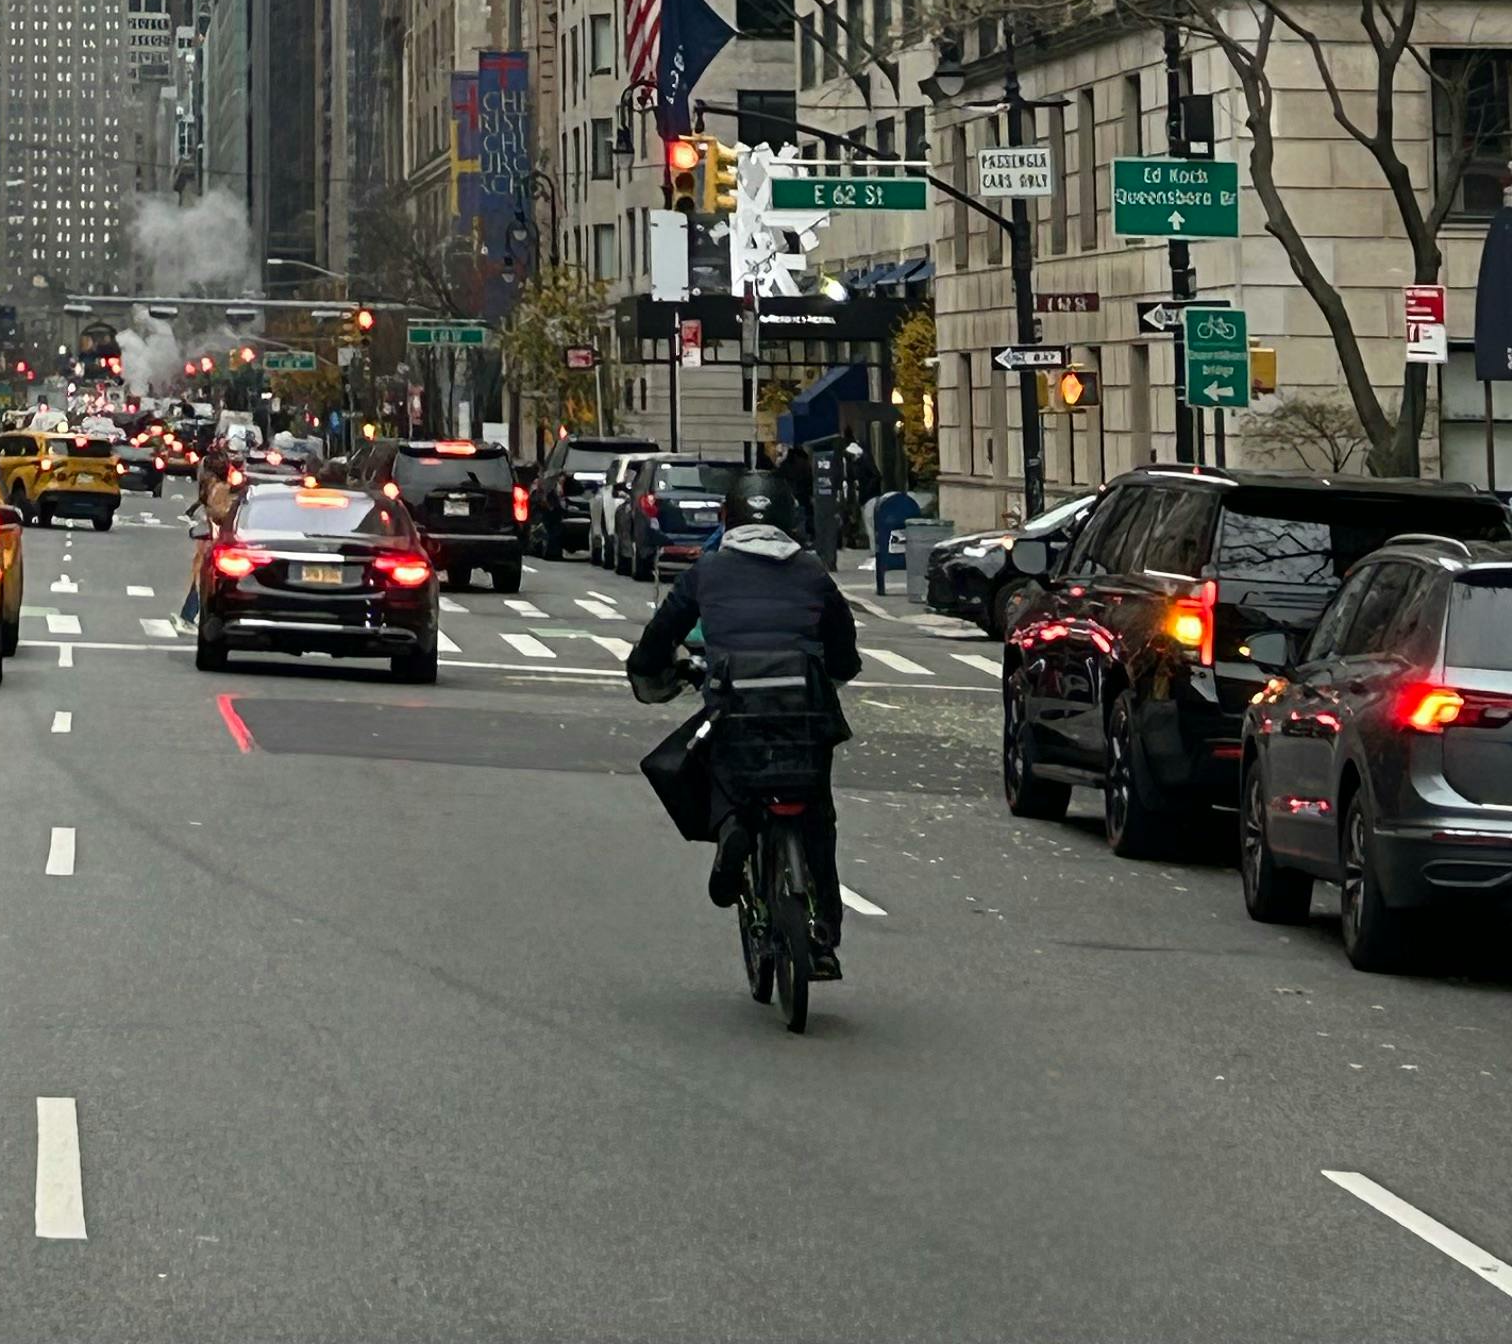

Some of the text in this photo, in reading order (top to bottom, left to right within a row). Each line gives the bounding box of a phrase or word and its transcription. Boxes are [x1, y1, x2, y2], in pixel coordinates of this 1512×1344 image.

[1143, 167, 1208, 184] Ed Koch
[814, 184, 885, 206] E 62 St
